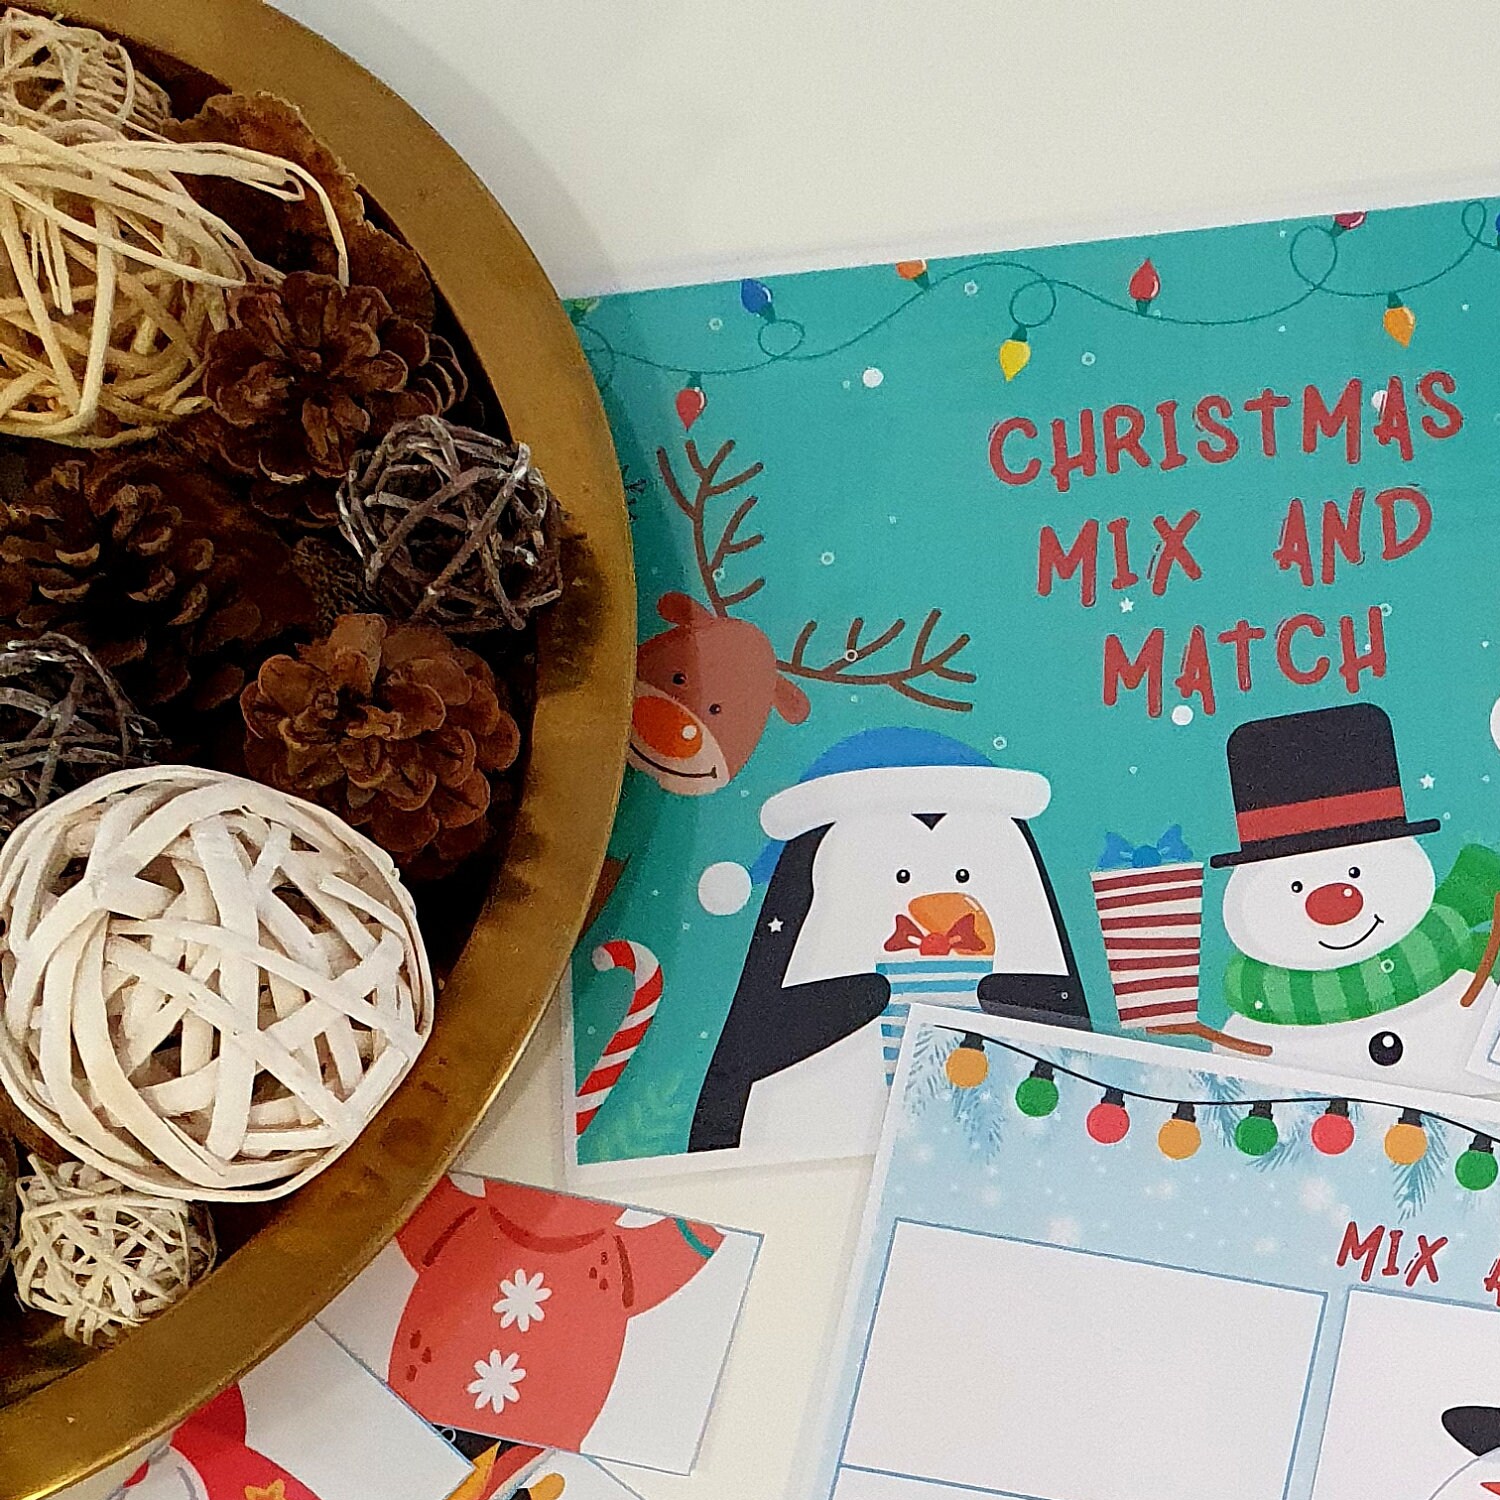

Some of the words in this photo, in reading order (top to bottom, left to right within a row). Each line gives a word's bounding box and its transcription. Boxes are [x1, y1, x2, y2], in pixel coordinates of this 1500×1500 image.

[989, 371, 1463, 492] CHRISTMAS
[1037, 510, 1201, 606] MIX
[1273, 487, 1432, 586] AND
[1103, 606, 1386, 716] MATCH
[1336, 1221, 1448, 1286] MIX
